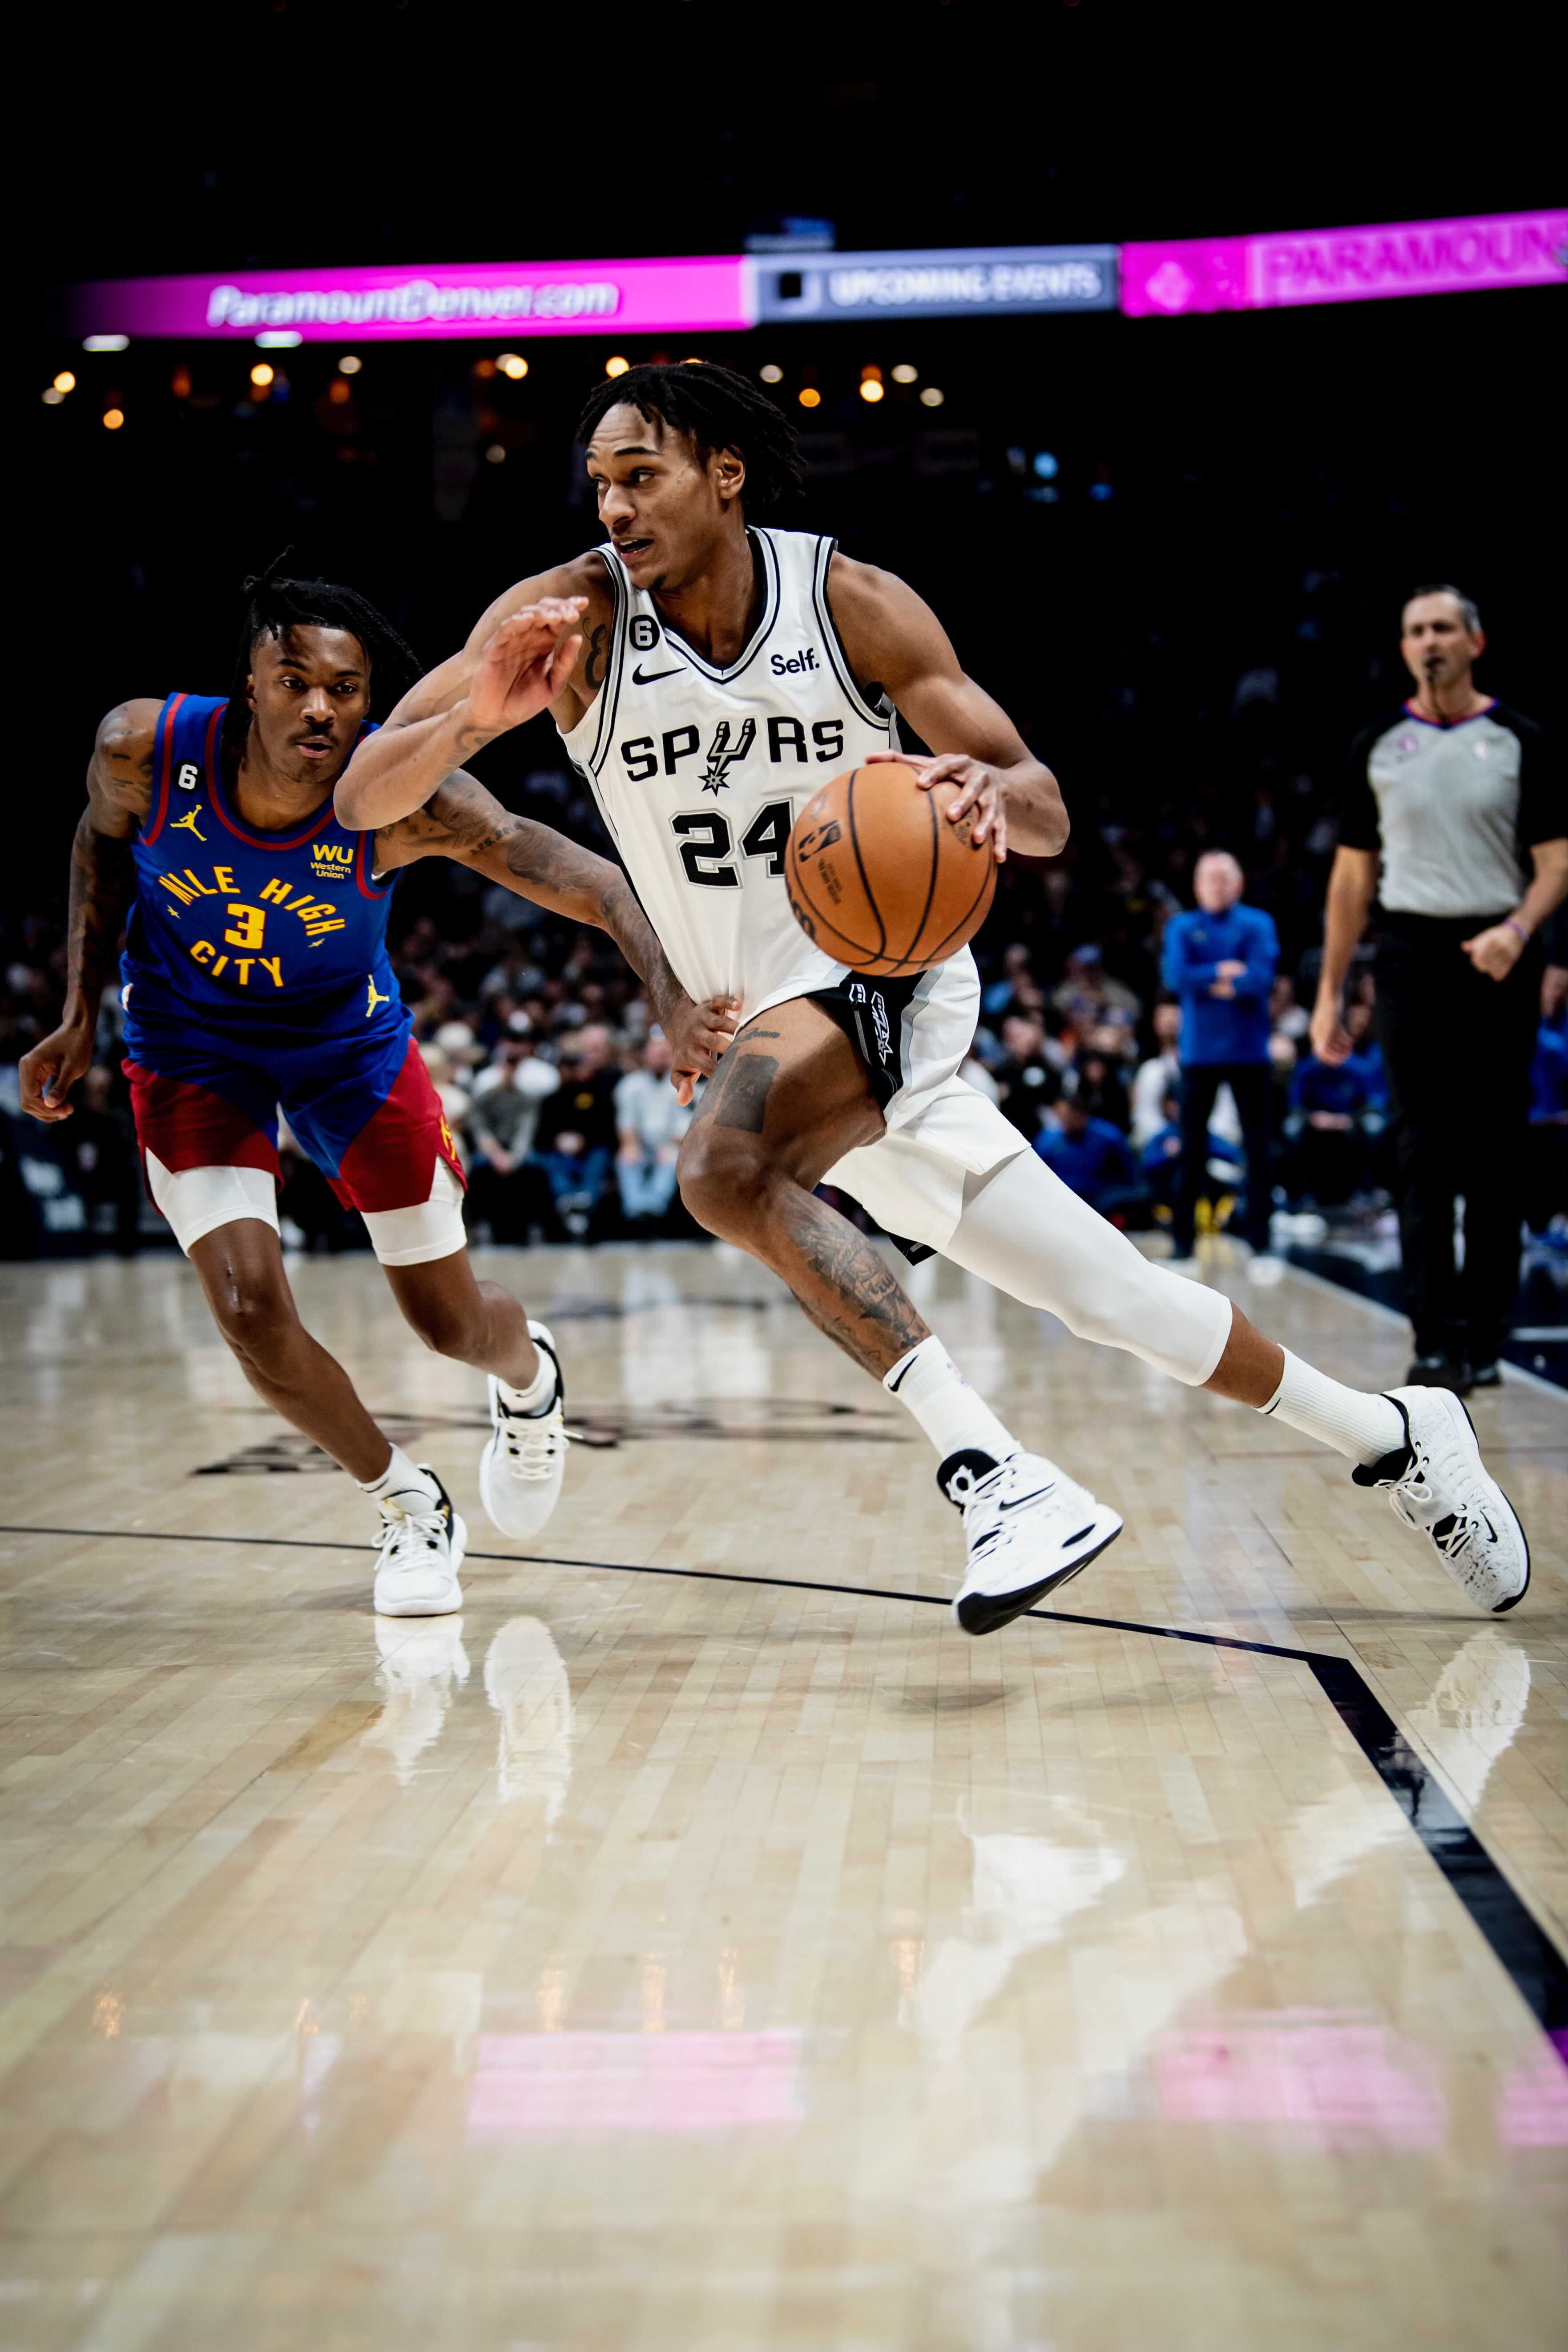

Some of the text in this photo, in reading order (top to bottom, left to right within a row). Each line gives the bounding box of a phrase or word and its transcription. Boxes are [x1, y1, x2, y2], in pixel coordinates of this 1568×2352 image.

[991, 262, 1101, 302] EVENTS
[634, 620, 653, 647] 6
[770, 648, 820, 675] Self.
[621, 716, 844, 794] SPURS
[178, 763, 198, 790] 6
[313, 844, 354, 864] WU
[668, 797, 794, 889] 24
[310, 862, 351, 874] Western
[316, 870, 344, 879] Union
[159, 866, 346, 937] MILE HIGH
[225, 903, 266, 950] 3
[190, 940, 284, 988] CITY
